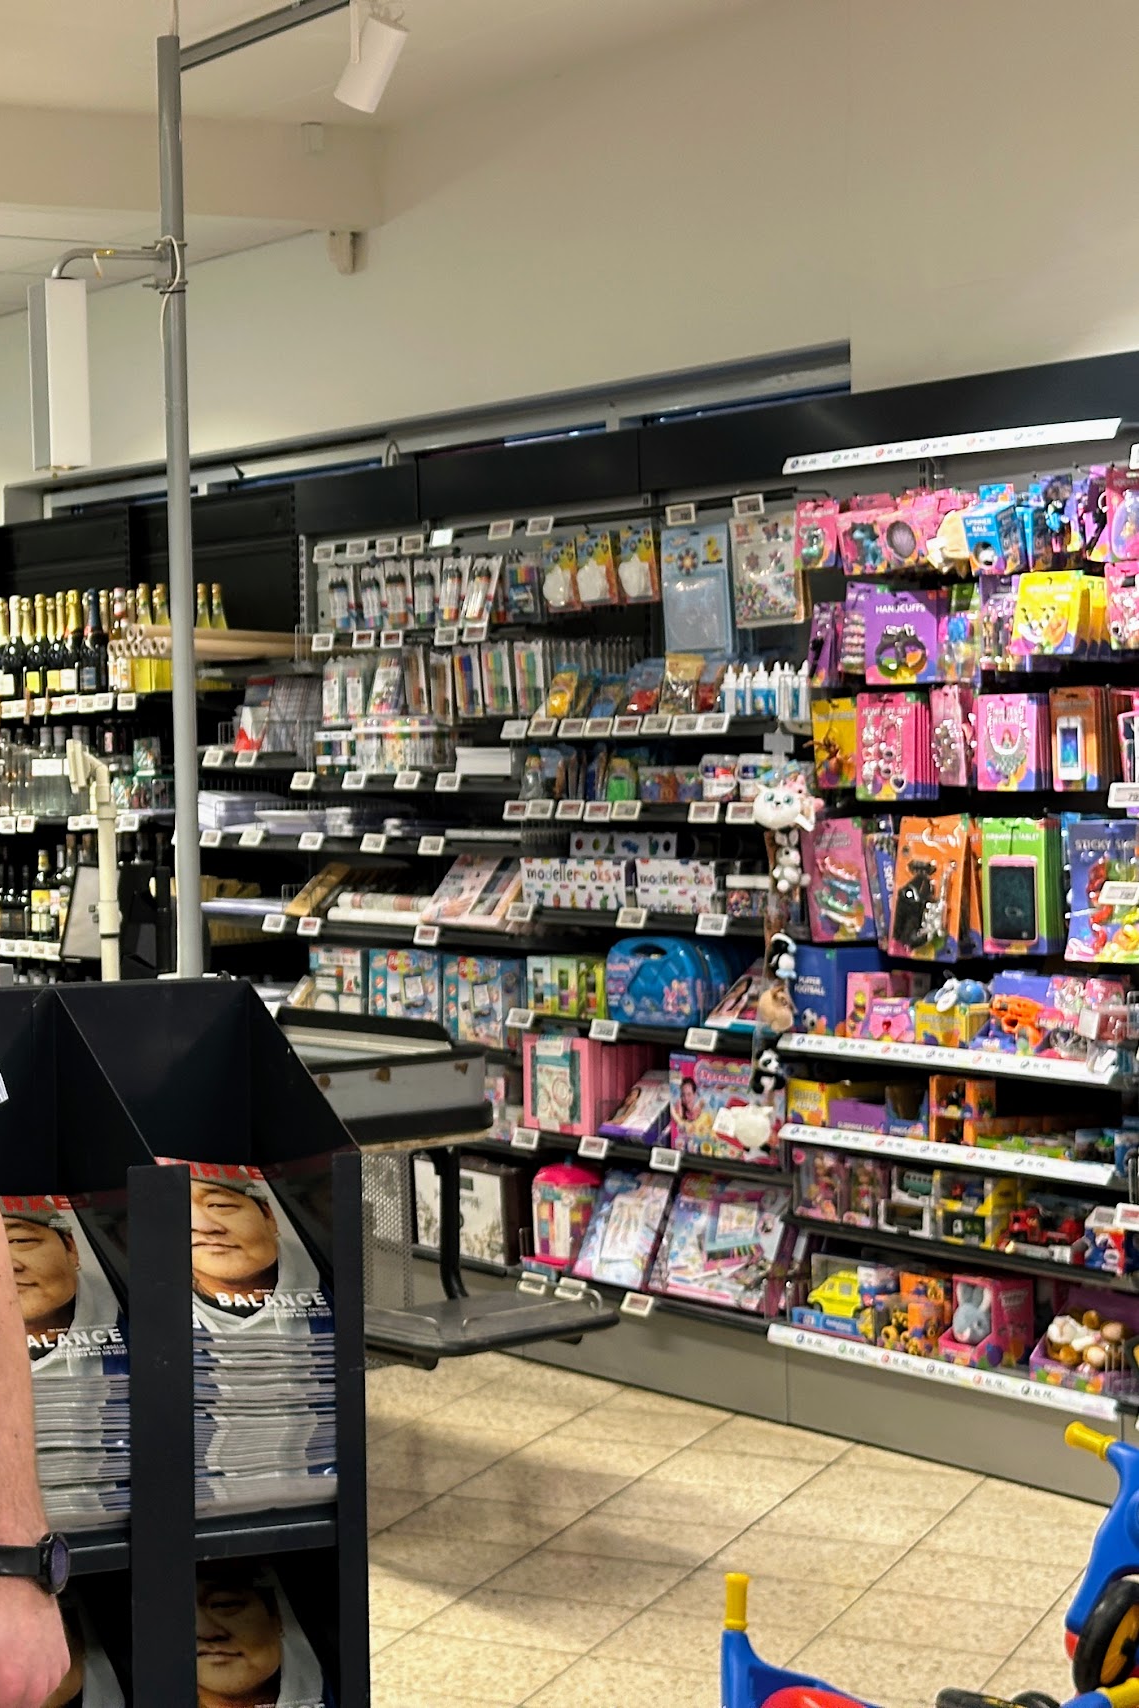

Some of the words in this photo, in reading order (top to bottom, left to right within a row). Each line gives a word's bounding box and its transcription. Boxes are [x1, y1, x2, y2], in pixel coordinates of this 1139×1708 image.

[1075, 838, 1111, 851] STICKY
[215, 1291, 327, 1307] BALANCE
[27, 1328, 123, 1348] ALANCE
